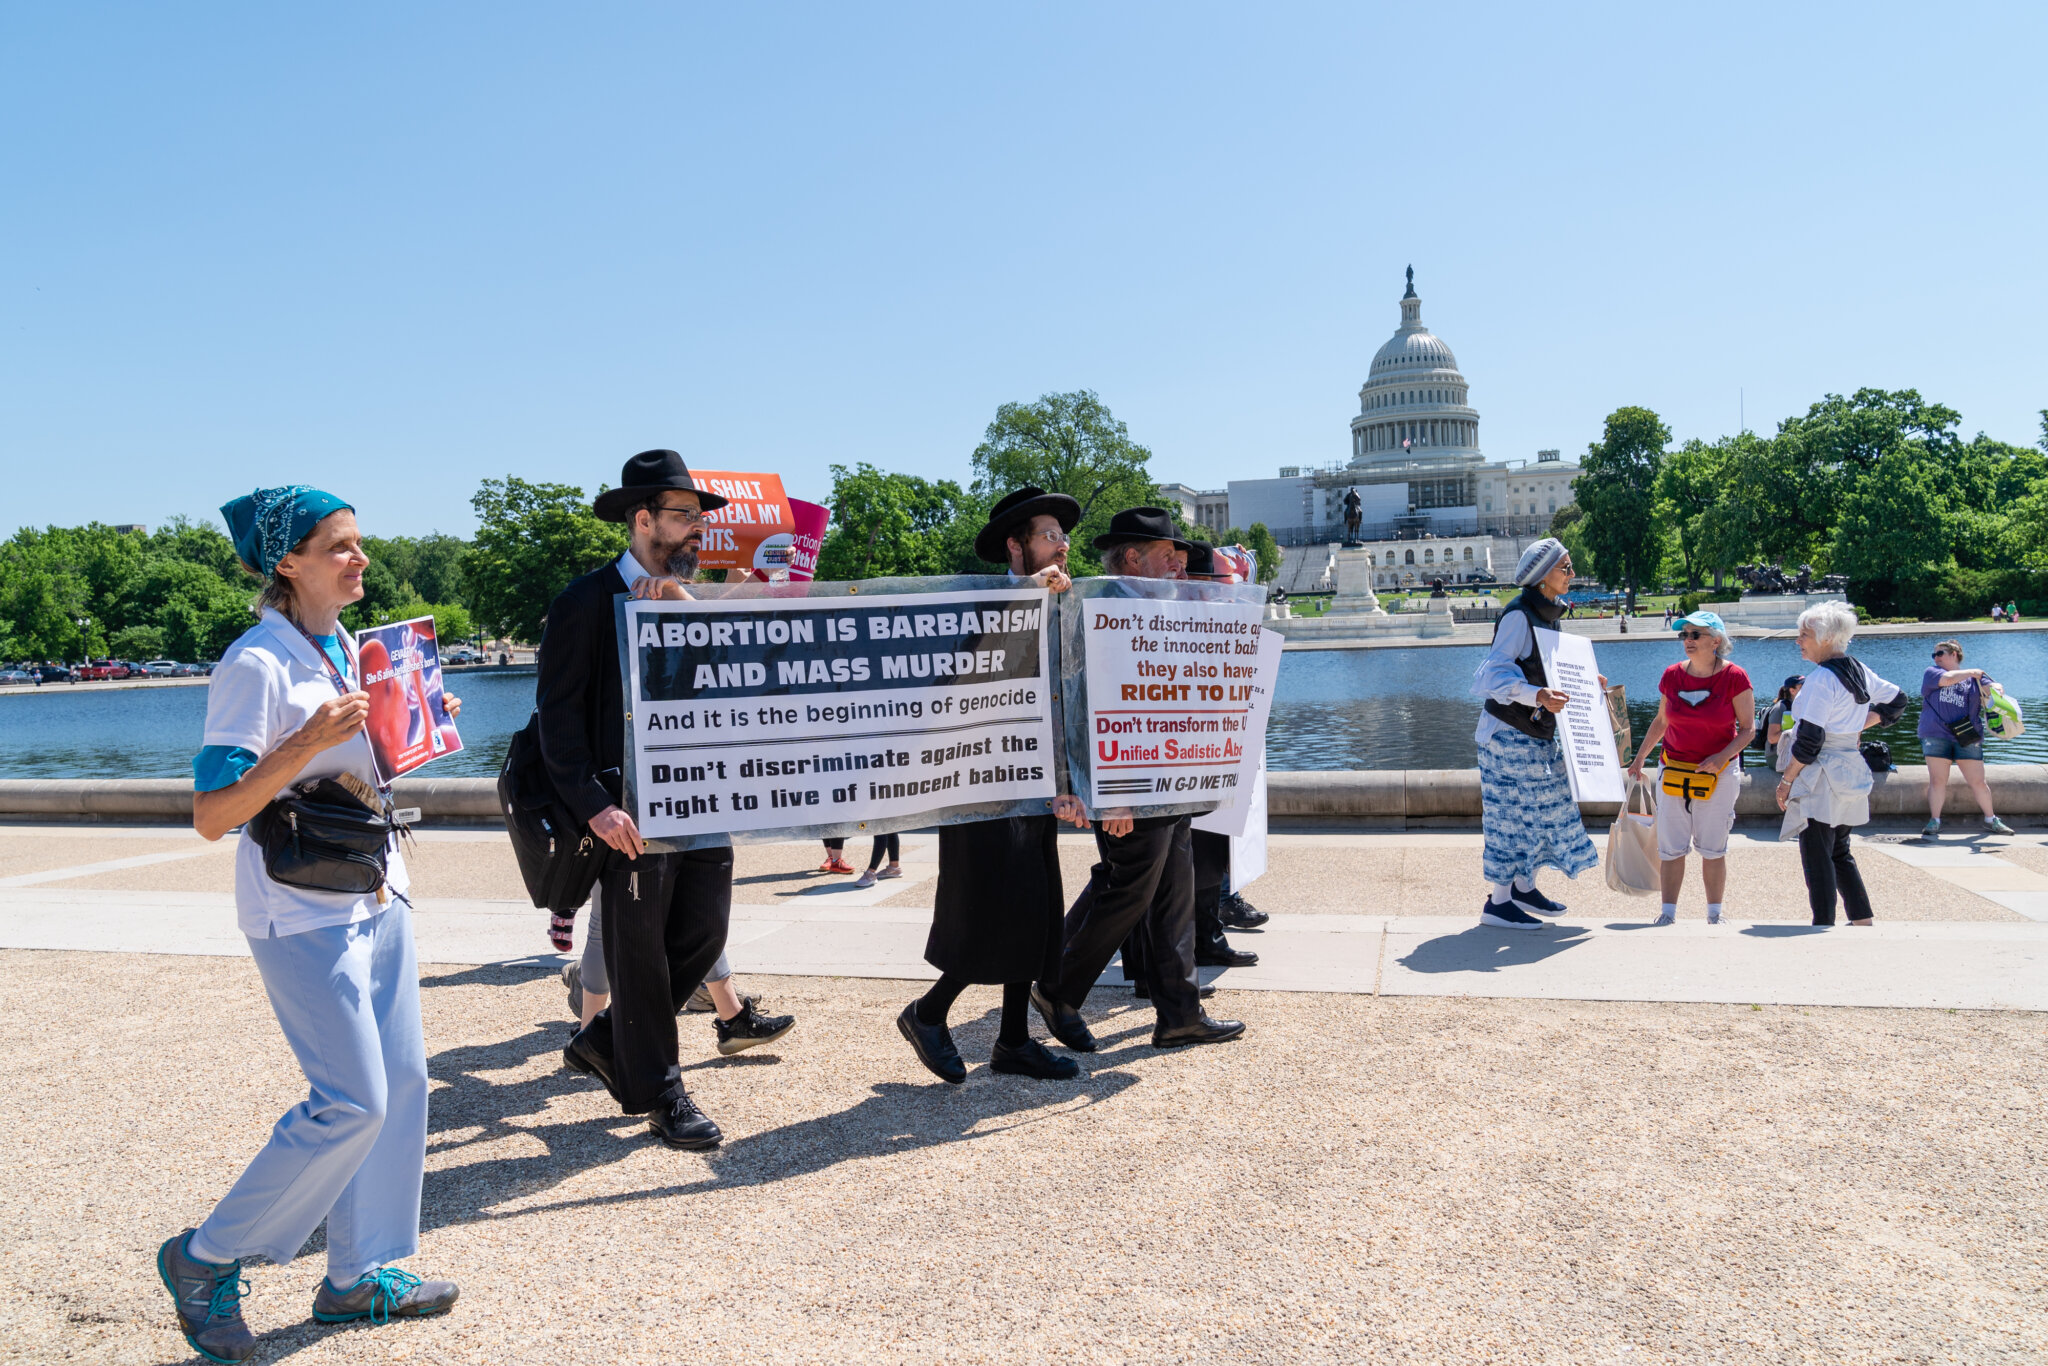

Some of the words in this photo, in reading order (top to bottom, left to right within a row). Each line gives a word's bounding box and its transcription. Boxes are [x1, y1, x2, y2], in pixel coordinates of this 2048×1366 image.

[710, 479, 763, 500] SHALT
[757, 503, 781, 524] MY
[698, 528, 739, 551] HTS.
[639, 618, 814, 648] ABORTION
[827, 616, 857, 642] IS
[868, 607, 1040, 640] BARBARISM
[1094, 613, 1143, 631] Don't
[1149, 615, 1247, 635] discriminate
[1131, 636, 1158, 652] the
[1163, 637, 1230, 655] innocent
[366, 672, 377, 686] She
[693, 661, 766, 689] AND
[778, 657, 871, 686] MASS
[881, 649, 1006, 680] MURDER
[1137, 660, 1177, 681] they
[1183, 661, 1218, 678] also
[1223, 662, 1253, 678] have
[1121, 683, 1191, 702] RIGHT
[1196, 685, 1224, 702] TO
[1940, 696, 1965, 707] RIGHTS!
[647, 710, 695, 731] And
[704, 708, 722, 729] it
[731, 707, 749, 727] is
[757, 704, 798, 726] the
[806, 697, 923, 723] beginning
[931, 694, 954, 715] of
[959, 688, 1037, 715] genocide
[1096, 716, 1143, 735] Don't
[1146, 716, 1219, 734] transform
[1222, 716, 1239, 732] the
[651, 760, 727, 784] Don't
[739, 748, 910, 778] discriminate
[920, 736, 992, 767] against
[1001, 734, 1038, 753] the
[1097, 740, 1159, 762] Unified
[1164, 738, 1221, 760] Sadistic
[649, 793, 721, 820] right
[731, 790, 758, 811] to
[770, 787, 820, 809] live
[832, 783, 858, 803] of
[869, 772, 960, 800] innocent
[969, 763, 1044, 787] babies
[1155, 777, 1171, 793] IN
[1174, 776, 1198, 791] G-D
[1199, 774, 1220, 789] WE
